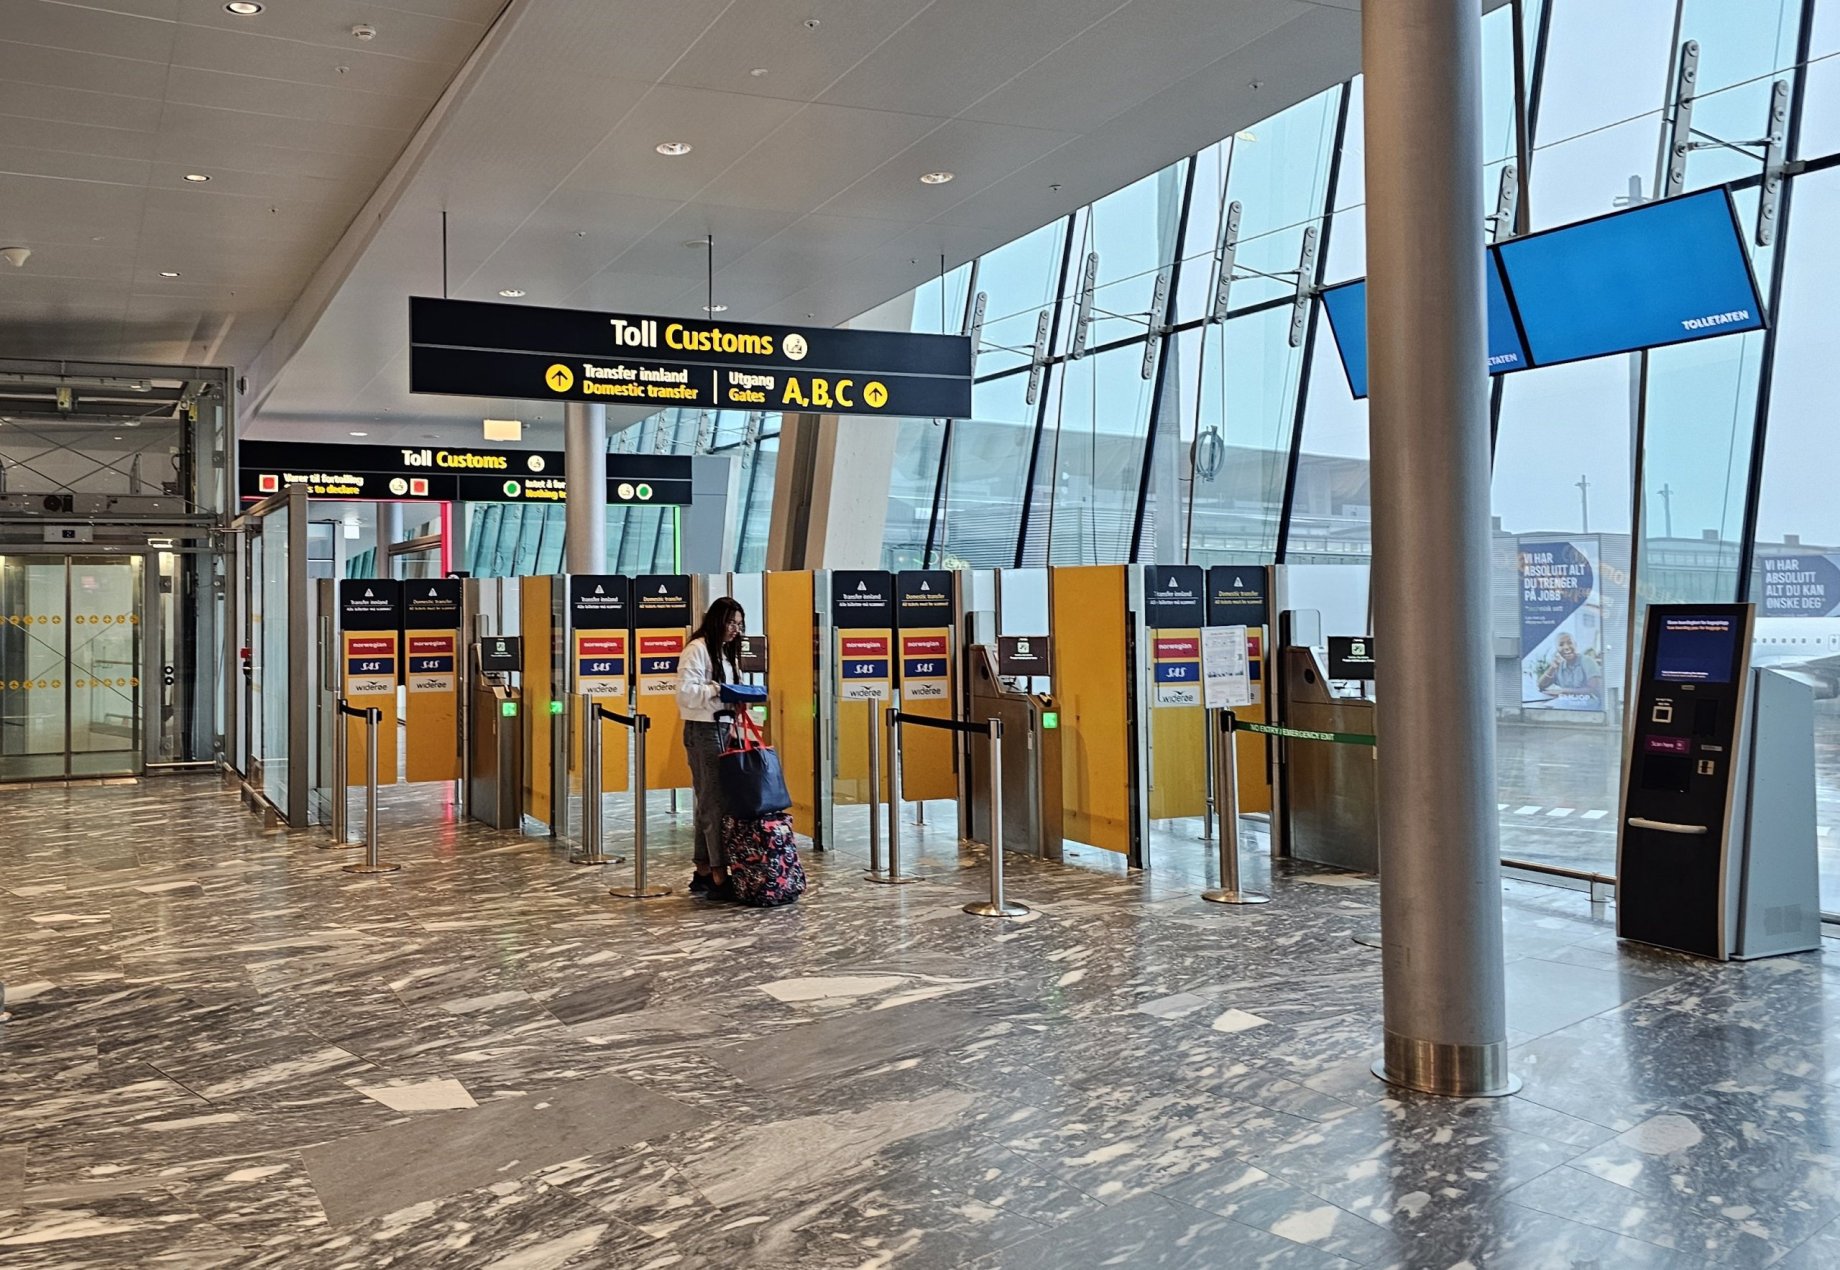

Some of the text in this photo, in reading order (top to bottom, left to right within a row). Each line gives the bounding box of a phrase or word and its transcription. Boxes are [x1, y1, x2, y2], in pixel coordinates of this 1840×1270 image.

[1682, 310, 1749, 330] TOLLETATEN
[610, 319, 774, 355] Toll Customs
[583, 364, 688, 383] Transfer innland
[728, 371, 774, 390] Utgang
[583, 380, 698, 399] Domestic transfer
[728, 388, 766, 403] Gates
[782, 377, 854, 408] A,B,C
[401, 449, 508, 469] Toll Customs
[326, 484, 360, 494] declare
[525, 488, 559, 500] Nothing
[1524, 552, 1554, 564] VI HAR
[1524, 564, 1586, 576] ABSOLUTT ALT
[1764, 559, 1800, 571] VI HAR
[1524, 577, 1578, 589] DU TRENGER
[1766, 572, 1816, 584] ABSOLUTT
[1524, 588, 1536, 601] PÅ
[1766, 584, 1825, 596] ALT DU KAN
[360, 662, 381, 670] SAS
[420, 660, 440, 669] SAS
[590, 662, 612, 672] SAS
[651, 661, 672, 670] SAS
[854, 664, 875, 674] SAS
[914, 663, 935, 673] SAS
[1166, 667, 1187, 678] SAS
[850, 689, 882, 697] widerøe
[911, 687, 942, 696] widerøe
[1162, 694, 1194, 702] widerøe
[1250, 724, 1260, 732] NO
[1260, 726, 1279, 735] ENTRY
[1282, 728, 1320, 740] EMERGENCY
